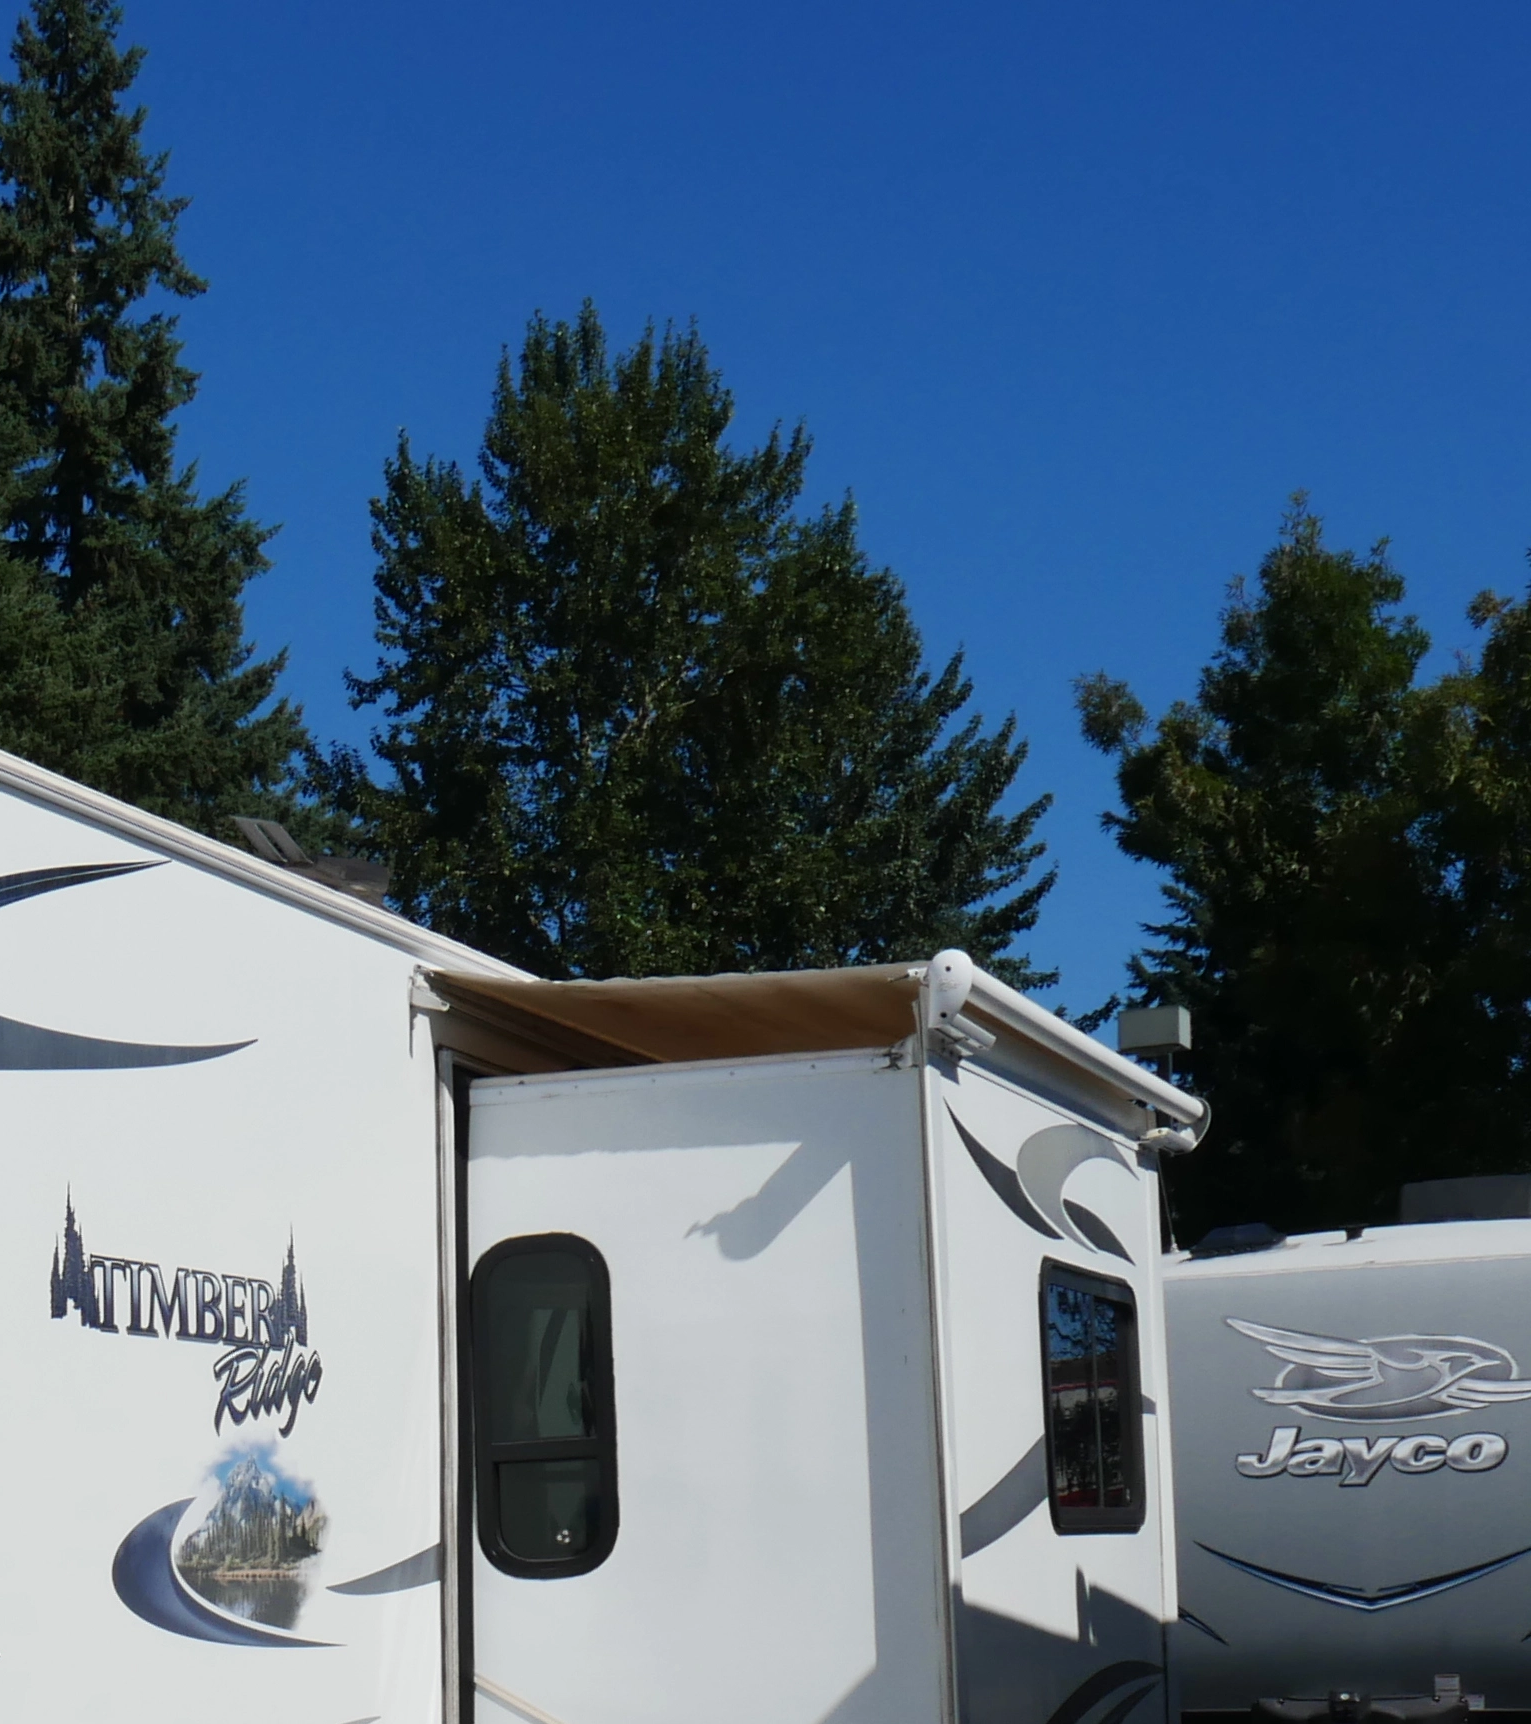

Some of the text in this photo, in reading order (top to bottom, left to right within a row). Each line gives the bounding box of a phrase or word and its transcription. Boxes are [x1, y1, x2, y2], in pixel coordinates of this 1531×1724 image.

[89, 1254, 284, 1350] TIMBER
[213, 1330, 324, 1438] Ridge
[1235, 1426, 1509, 1487] Jayco
